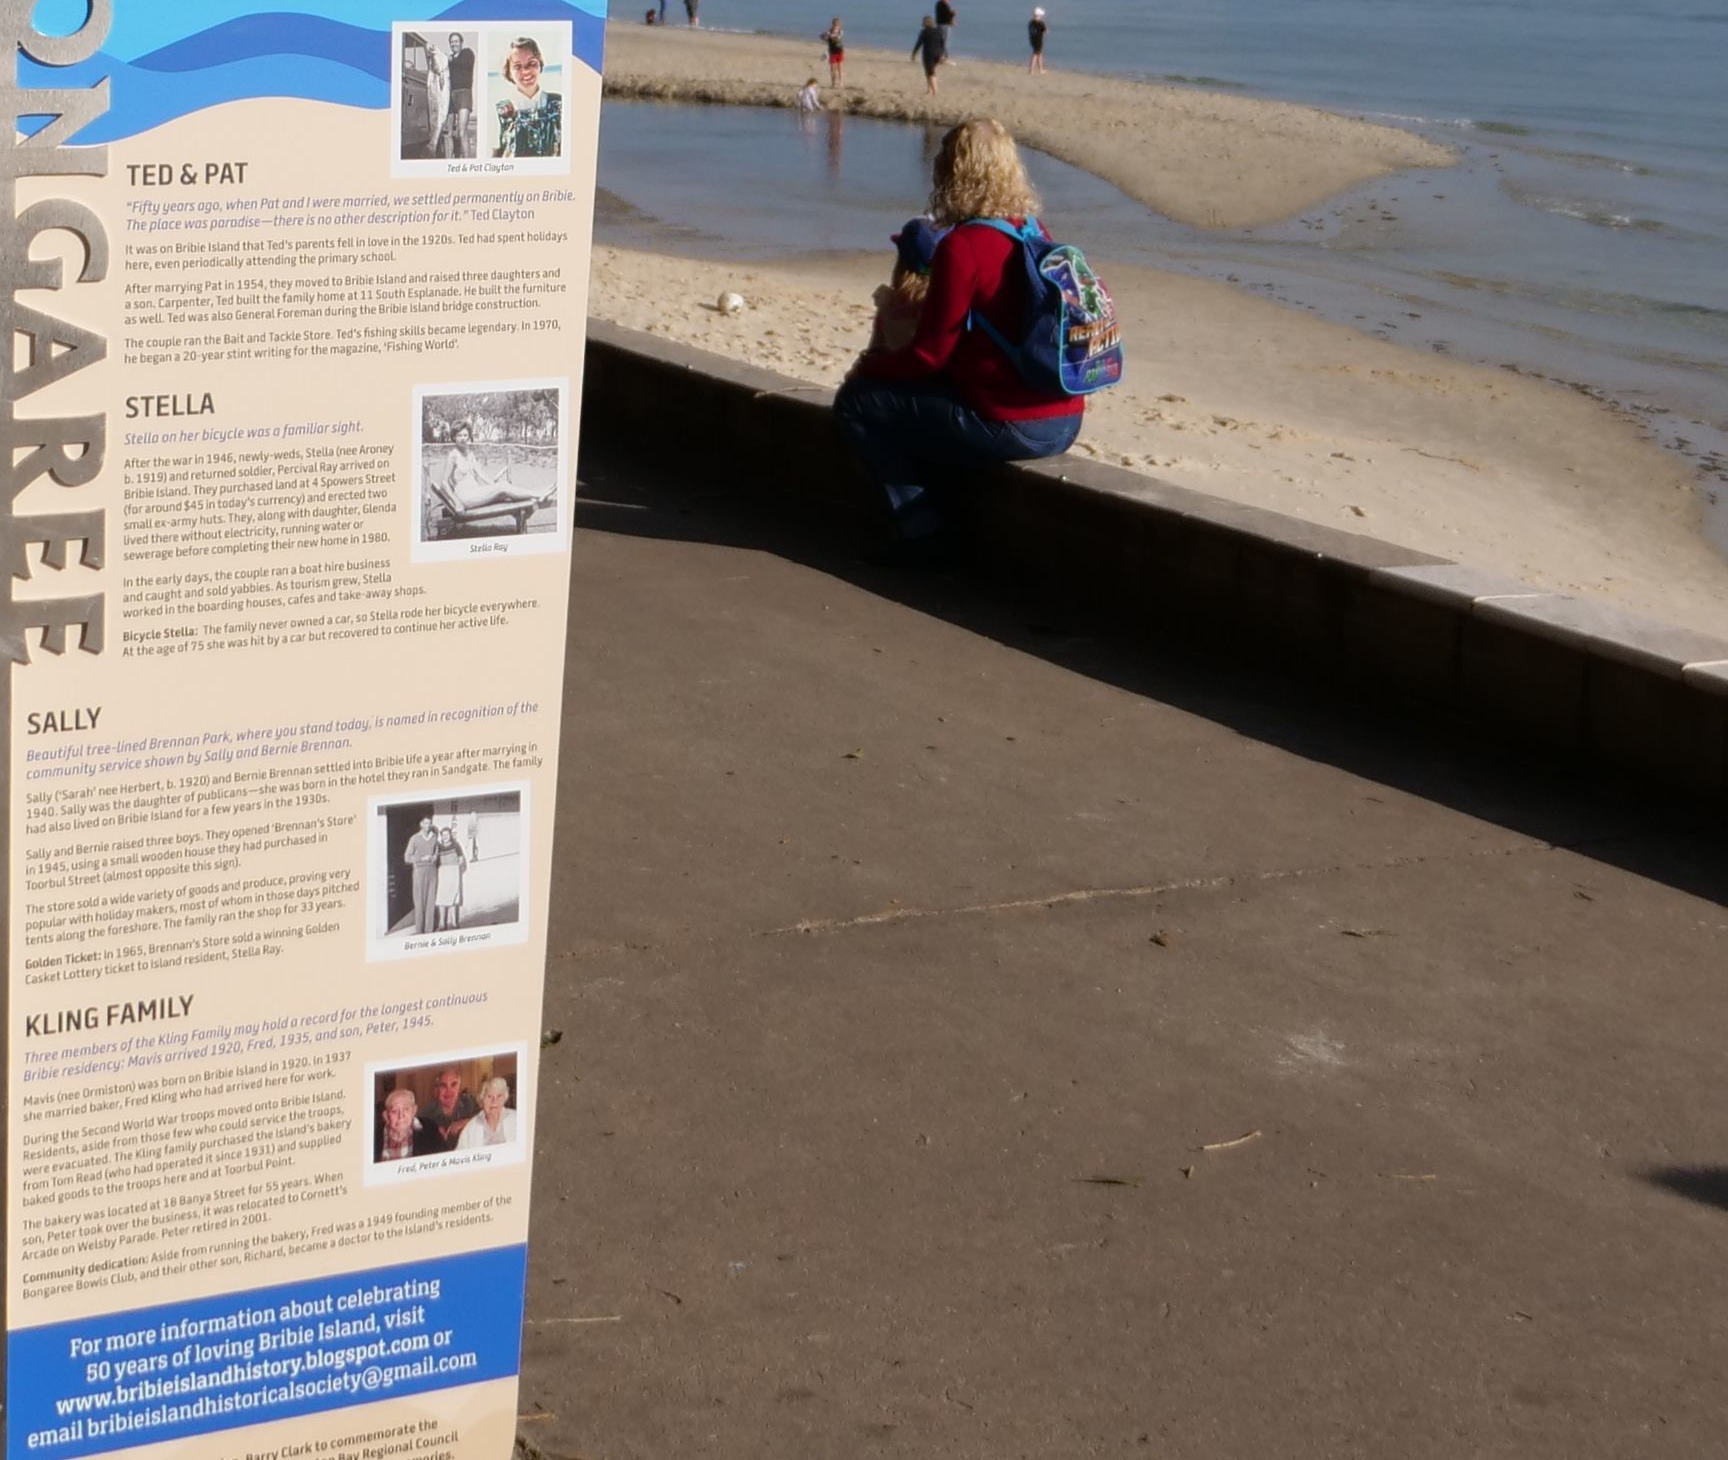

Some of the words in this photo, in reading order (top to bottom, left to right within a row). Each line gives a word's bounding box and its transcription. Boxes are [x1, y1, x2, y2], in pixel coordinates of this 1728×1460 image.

[126, 164, 172, 186] TED
[180, 163, 197, 185] &
[205, 162, 248, 184] PAT
[127, 218, 147, 230] The
[148, 218, 181, 233] place
[184, 219, 207, 229] was
[306, 213, 315, 225] is
[317, 216, 331, 225] no
[333, 212, 365, 224] other
[367, 210, 429, 225] description
[431, 209, 448, 224] for
[470, 208, 489, 220] Ted
[492, 208, 534, 222] Clayton
[162, 202, 195, 215] years
[197, 201, 222, 214] ago,
[226, 198, 257, 210] when
[260, 197, 279, 209] Pat
[282, 196, 304, 208] and
[306, 196, 310, 207] I
[312, 198, 340, 208] were
[342, 194, 390, 207] married,
[393, 196, 409, 205] we
[411, 192, 451, 205] settled
[452, 190, 524, 206] permanently
[526, 193, 539, 202] on
[541, 189, 575, 201] Bribie.
[125, 393, 214, 418] STELLA
[124, 432, 158, 445] Stella
[161, 433, 176, 443] on
[179, 430, 199, 442] her
[201, 427, 244, 443] bicycle
[247, 427, 270, 438] was
[272, 427, 280, 436] a
[282, 422, 329, 438] familiar
[331, 420, 363, 435] sight.
[26, 744, 83, 761] Beautiful
[86, 737, 147, 755] tree-lined
[149, 736, 199, 749] Brennan
[202, 731, 232, 744] Park,
[236, 728, 272, 741] where
[275, 727, 297, 740] you
[299, 720, 333, 735] stand
[335, 718, 371, 732] today,
[375, 716, 384, 727] is
[386, 711, 425, 726] named
[427, 710, 437, 722] in
[440, 704, 504, 722] recognition
[506, 702, 518, 716] of
[520, 701, 538, 713] the
[27, 707, 101, 734] SALLY
[26, 762, 96, 780] community
[99, 757, 141, 772] service
[144, 755, 184, 768] shown
[186, 751, 201, 766] by
[204, 748, 233, 763] Sally
[236, 745, 259, 759] and
[260, 744, 297, 756] Bernie
[300, 738, 352, 752] Brennan.
[25, 1051, 58, 1063] Three
[61, 1042, 117, 1058] members
[120, 1037, 133, 1052] of
[135, 1035, 155, 1049] the
[158, 1031, 188, 1046] Kling
[191, 1025, 231, 1040] Family
[233, 1023, 259, 1036] may
[262, 1016, 288, 1031] hold
[290, 1018, 297, 1027] a
[300, 1009, 338, 1026] record
[339, 1008, 357, 1023] for
[360, 1005, 378, 1018] the
[380, 999, 423, 1016] longest
[425, 992, 487, 1009] continuous
[26, 1007, 98, 1037] KLING
[107, 994, 193, 1026] FAMILY
[23, 1066, 59, 1082] Bribie
[61, 1059, 124, 1076] residency:
[127, 1052, 161, 1067] Mavis
[164, 1044, 208, 1062] arrived
[210, 1040, 243, 1056] 1920,
[246, 1035, 276, 1051] Fred,
[280, 1031, 311, 1046] 1935,
[315, 1027, 337, 1041] and
[339, 1027, 362, 1038] son,
[365, 1021, 398, 1034] Peter,
[402, 1014, 433, 1029] 1945.
[70, 1337, 102, 1357] For
[105, 1329, 156, 1351] more
[160, 1308, 275, 1341] information
[279, 1295, 333, 1321] about
[337, 1279, 439, 1310] celebrating
[86, 1361, 110, 1382] 50
[114, 1354, 168, 1382] years
[172, 1344, 192, 1367] of
[194, 1339, 254, 1363] loving
[259, 1326, 314, 1351] Bribie
[318, 1313, 380, 1340] Island,
[384, 1305, 424, 1328] visit
[56, 1334, 429, 1415] www.bribieislandhistory.blogspot.com
[433, 1330, 452, 1346] or
[27, 1419, 82, 1448] email
[87, 1352, 476, 1437] bribieislandhistoricalsociety@gmail.com
[281, 1442, 312, 1458] Clark
[315, 1441, 328, 1451] to
[330, 1424, 416, 1449] commemorate
[418, 1419, 438, 1432] the
[363, 1440, 413, 1458] Regional
[415, 1430, 459, 1449] Council
